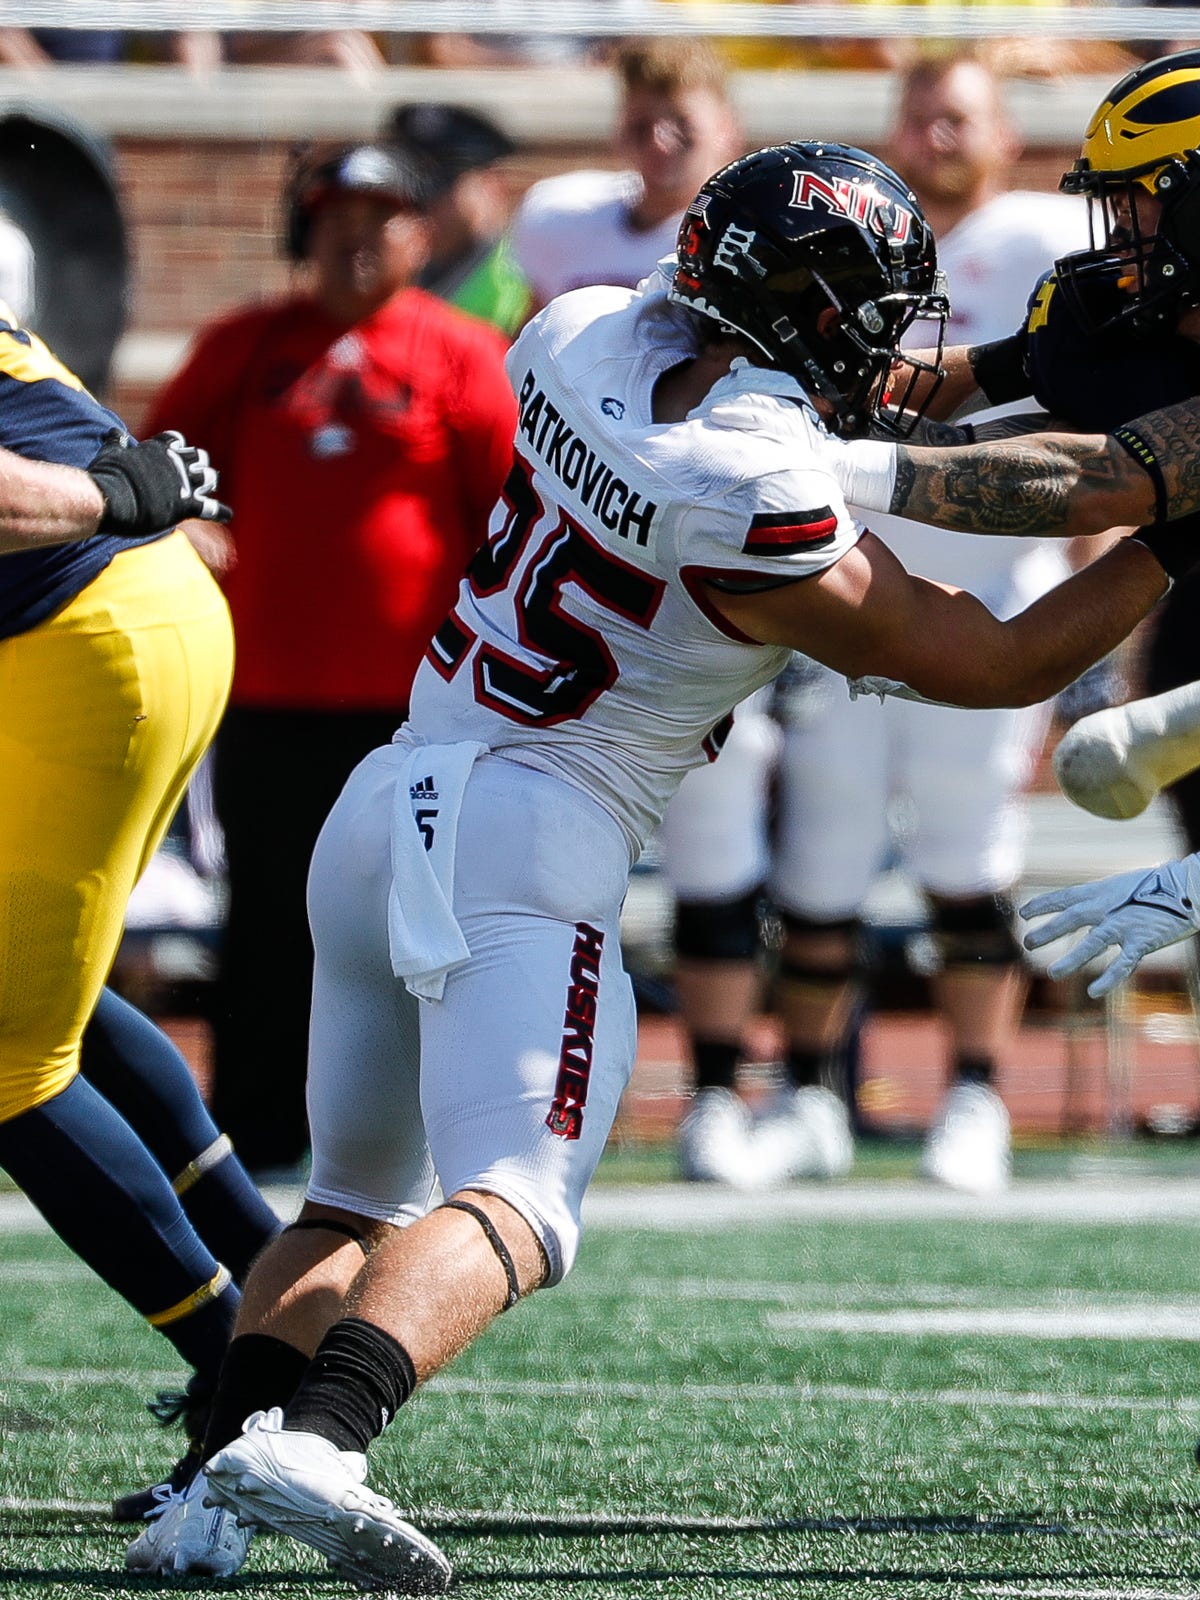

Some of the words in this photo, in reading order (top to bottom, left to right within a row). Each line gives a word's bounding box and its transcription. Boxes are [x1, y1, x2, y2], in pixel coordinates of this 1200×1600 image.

[788, 169, 913, 248] NIU
[518, 367, 658, 548] RATKOVICH
[1114, 429, 1156, 464] JORDAN
[426, 447, 668, 728] 25
[545, 921, 605, 1141] HUSKIES
